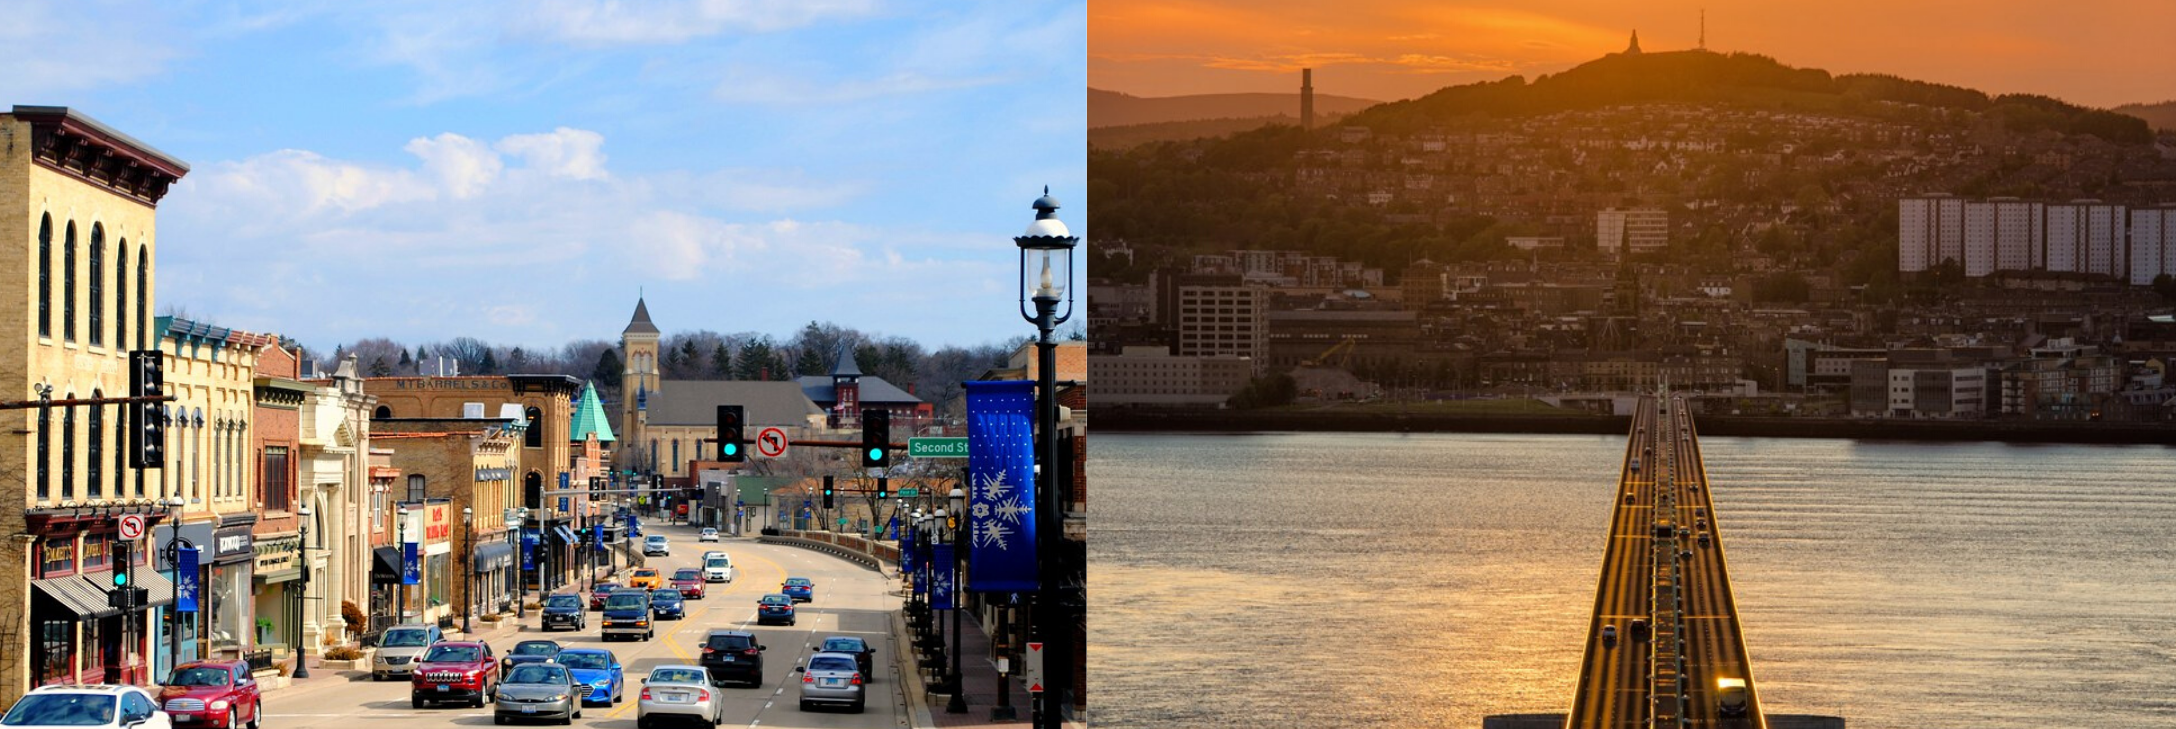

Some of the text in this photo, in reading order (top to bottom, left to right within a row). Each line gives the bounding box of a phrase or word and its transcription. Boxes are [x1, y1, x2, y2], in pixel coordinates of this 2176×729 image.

[417, 380, 479, 389] BARRELS
[915, 442, 968, 453] Second St
